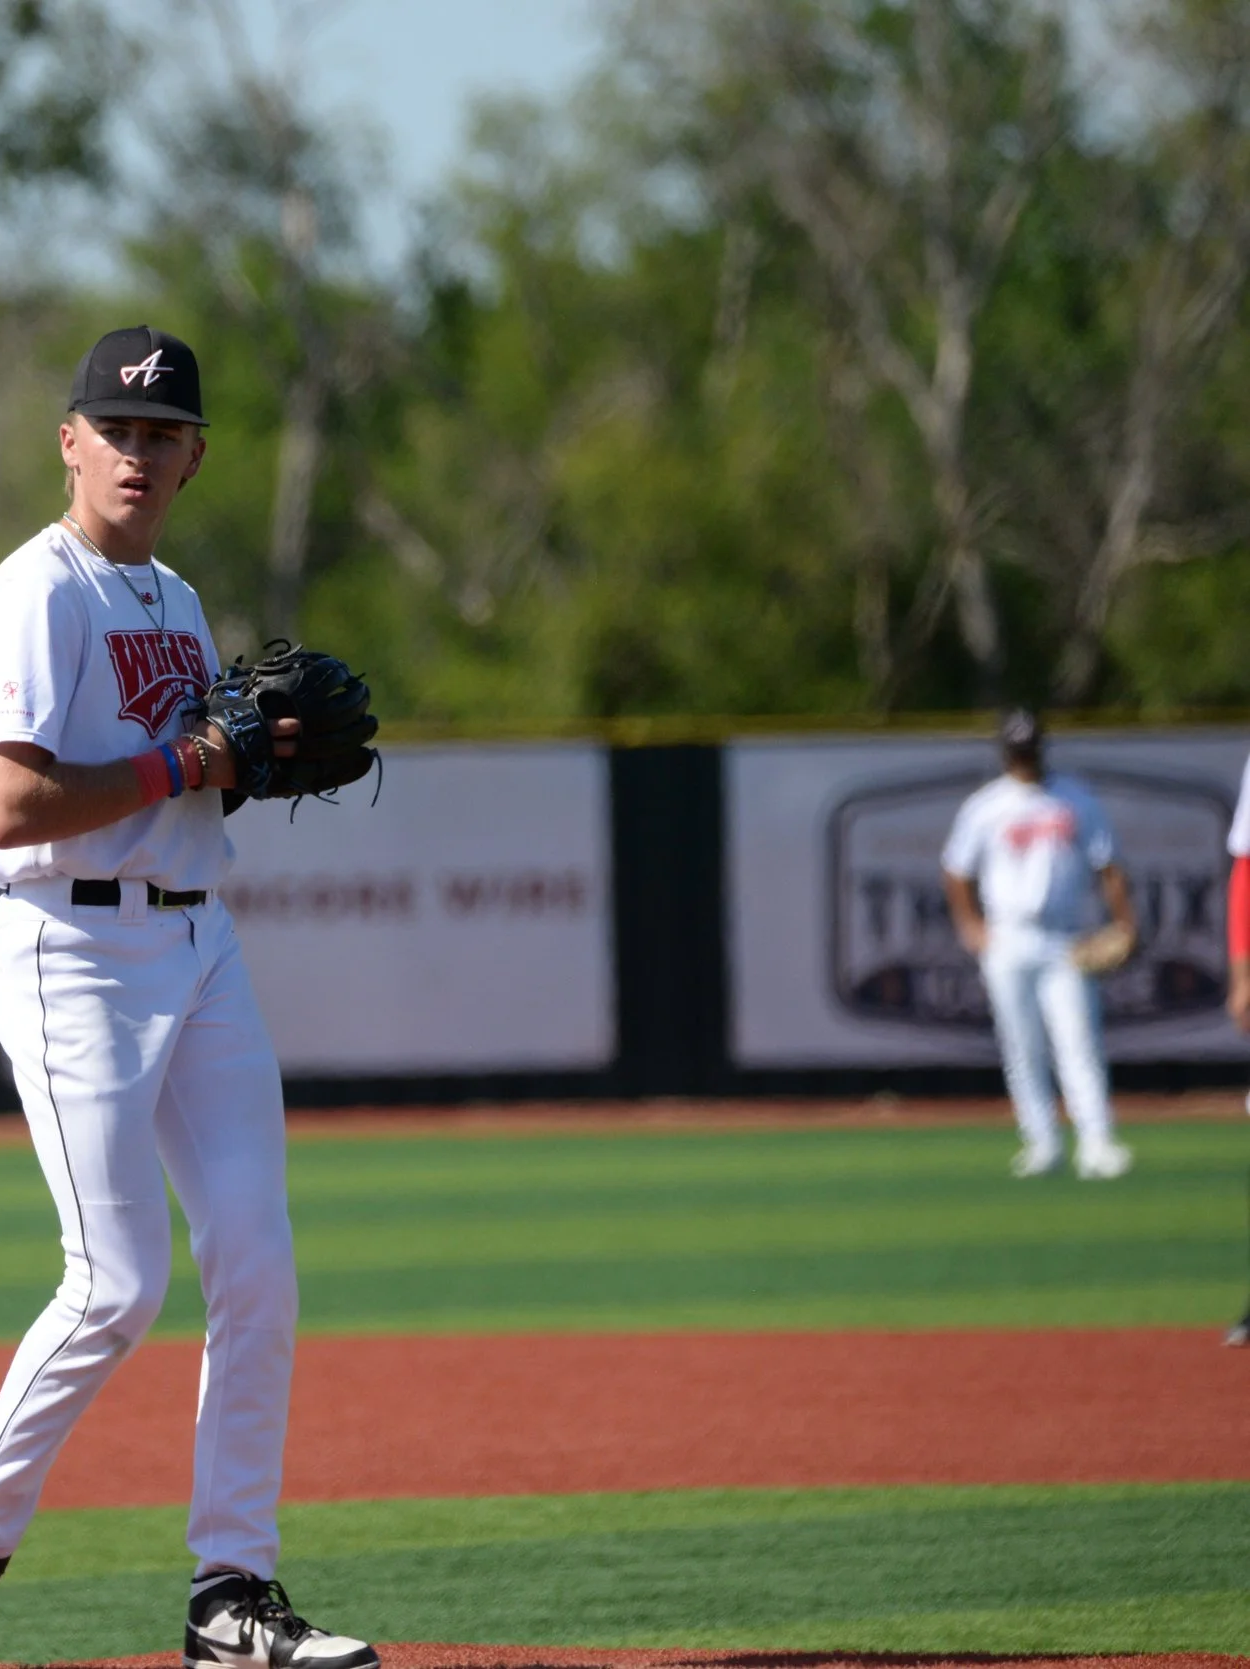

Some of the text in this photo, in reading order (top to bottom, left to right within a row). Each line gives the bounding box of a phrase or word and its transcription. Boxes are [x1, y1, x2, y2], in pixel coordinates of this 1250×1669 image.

[120, 348, 174, 388] A
[106, 630, 209, 708] WING
[170, 681, 183, 694] TX
[224, 873, 412, 924] NCORE
